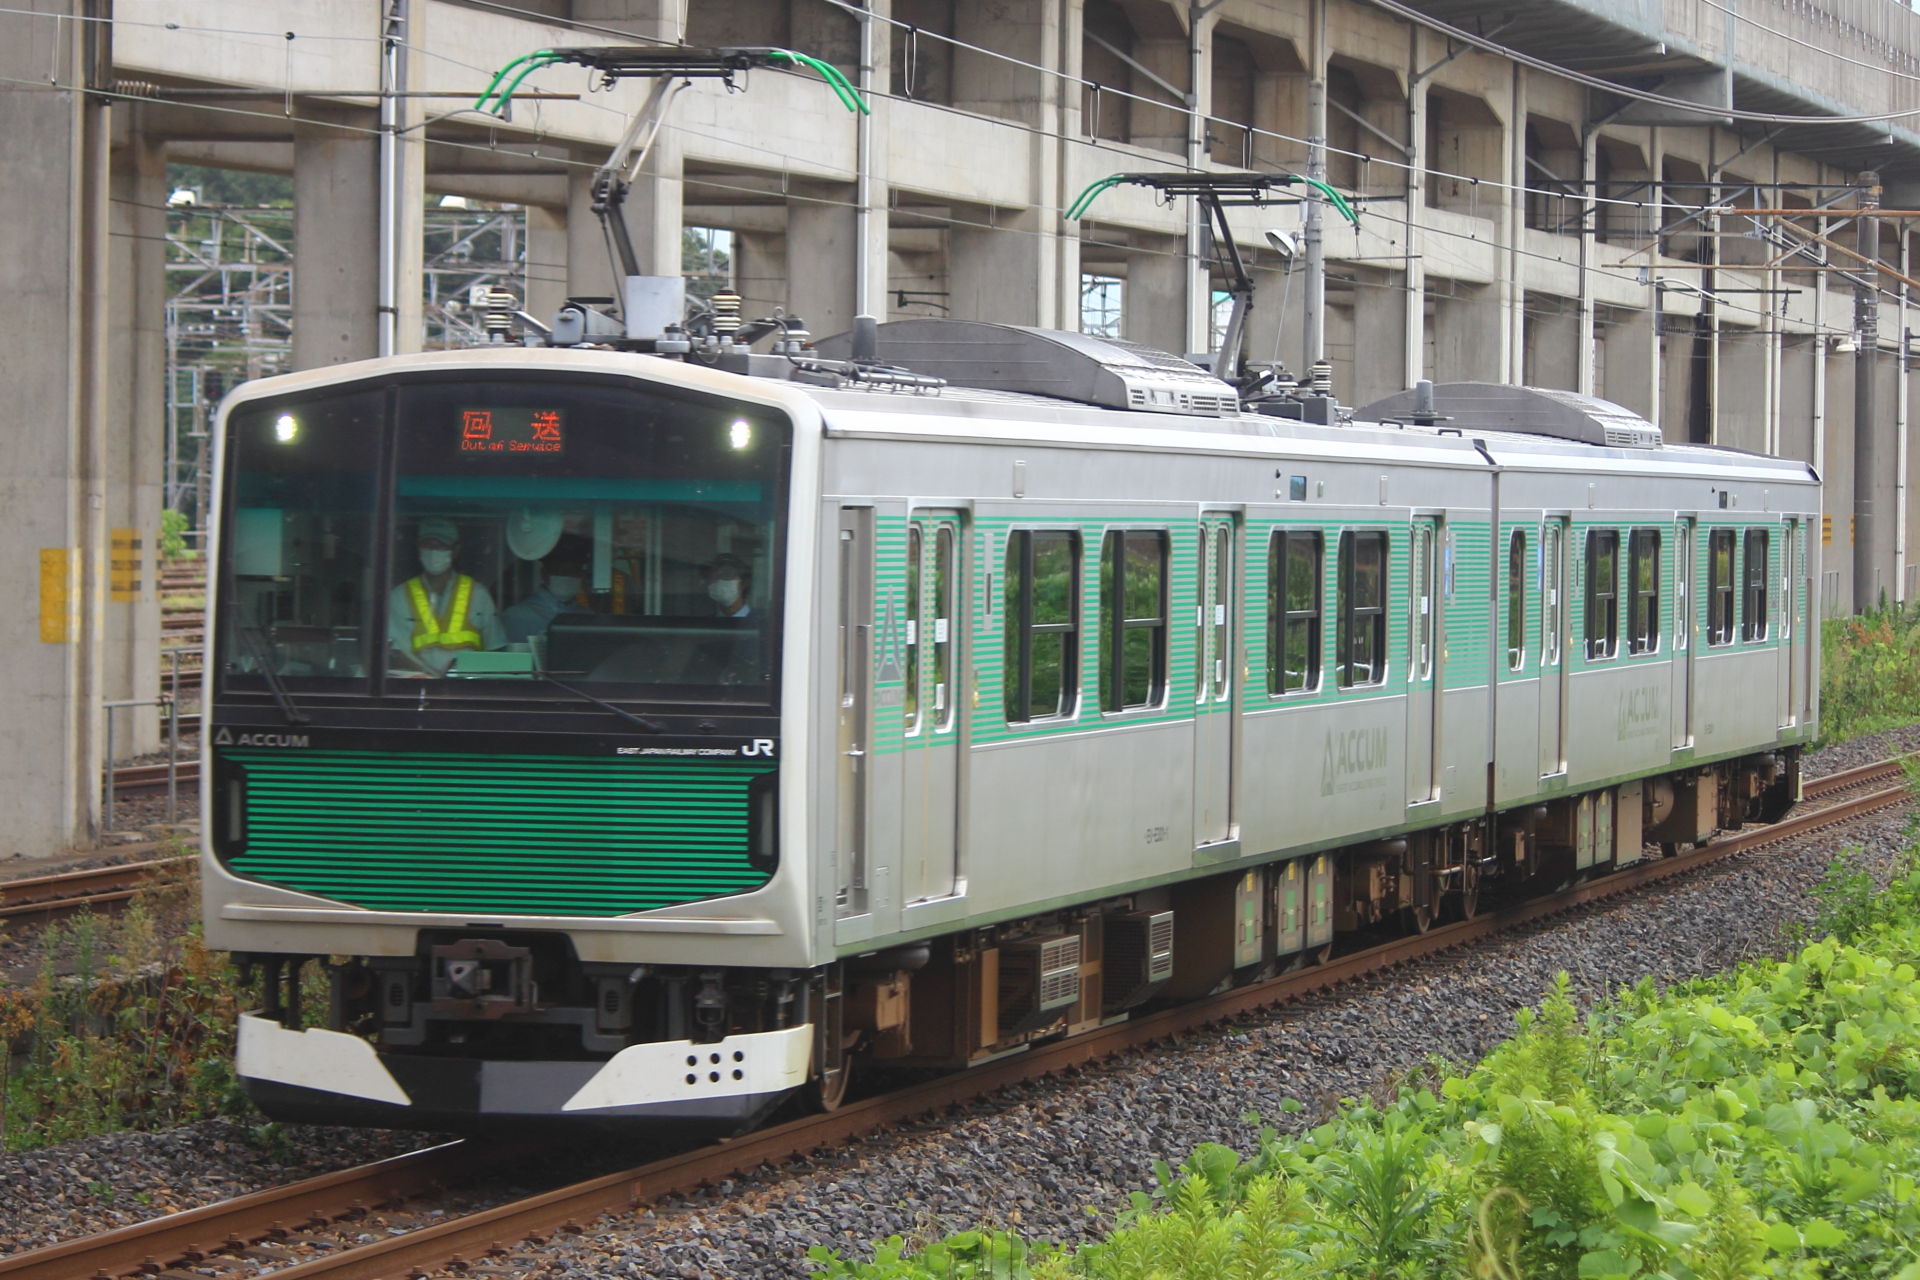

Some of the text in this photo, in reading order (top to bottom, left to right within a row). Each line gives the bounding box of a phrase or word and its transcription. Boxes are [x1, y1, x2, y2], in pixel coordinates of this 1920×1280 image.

[461, 440, 561, 452] Out of Service
[238, 733, 310, 747] ACCUM
[741, 738, 775, 757] JR
[1336, 727, 1387, 775] ACCUM
